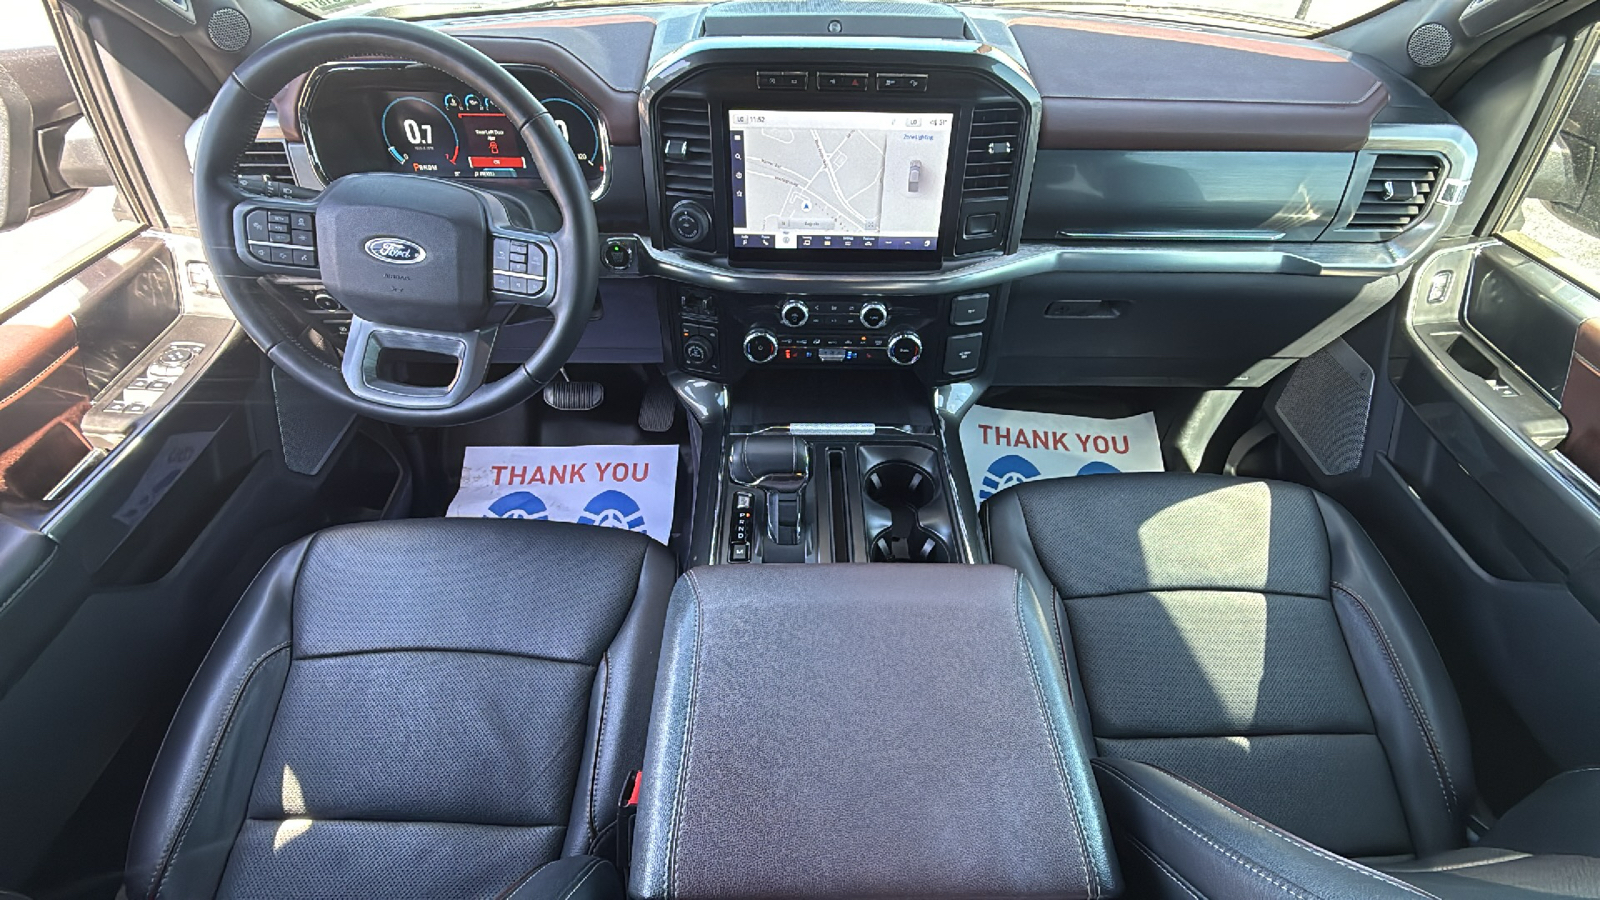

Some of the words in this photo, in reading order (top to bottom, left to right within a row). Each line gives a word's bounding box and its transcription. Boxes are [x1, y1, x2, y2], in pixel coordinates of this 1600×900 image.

[403, 119, 433, 144] 0.7
[379, 242, 411, 259] Ford
[978, 424, 1071, 452] THANK
[1075, 433, 1130, 455] YOU
[491, 462, 588, 486] THANK
[595, 462, 650, 483] YOU
